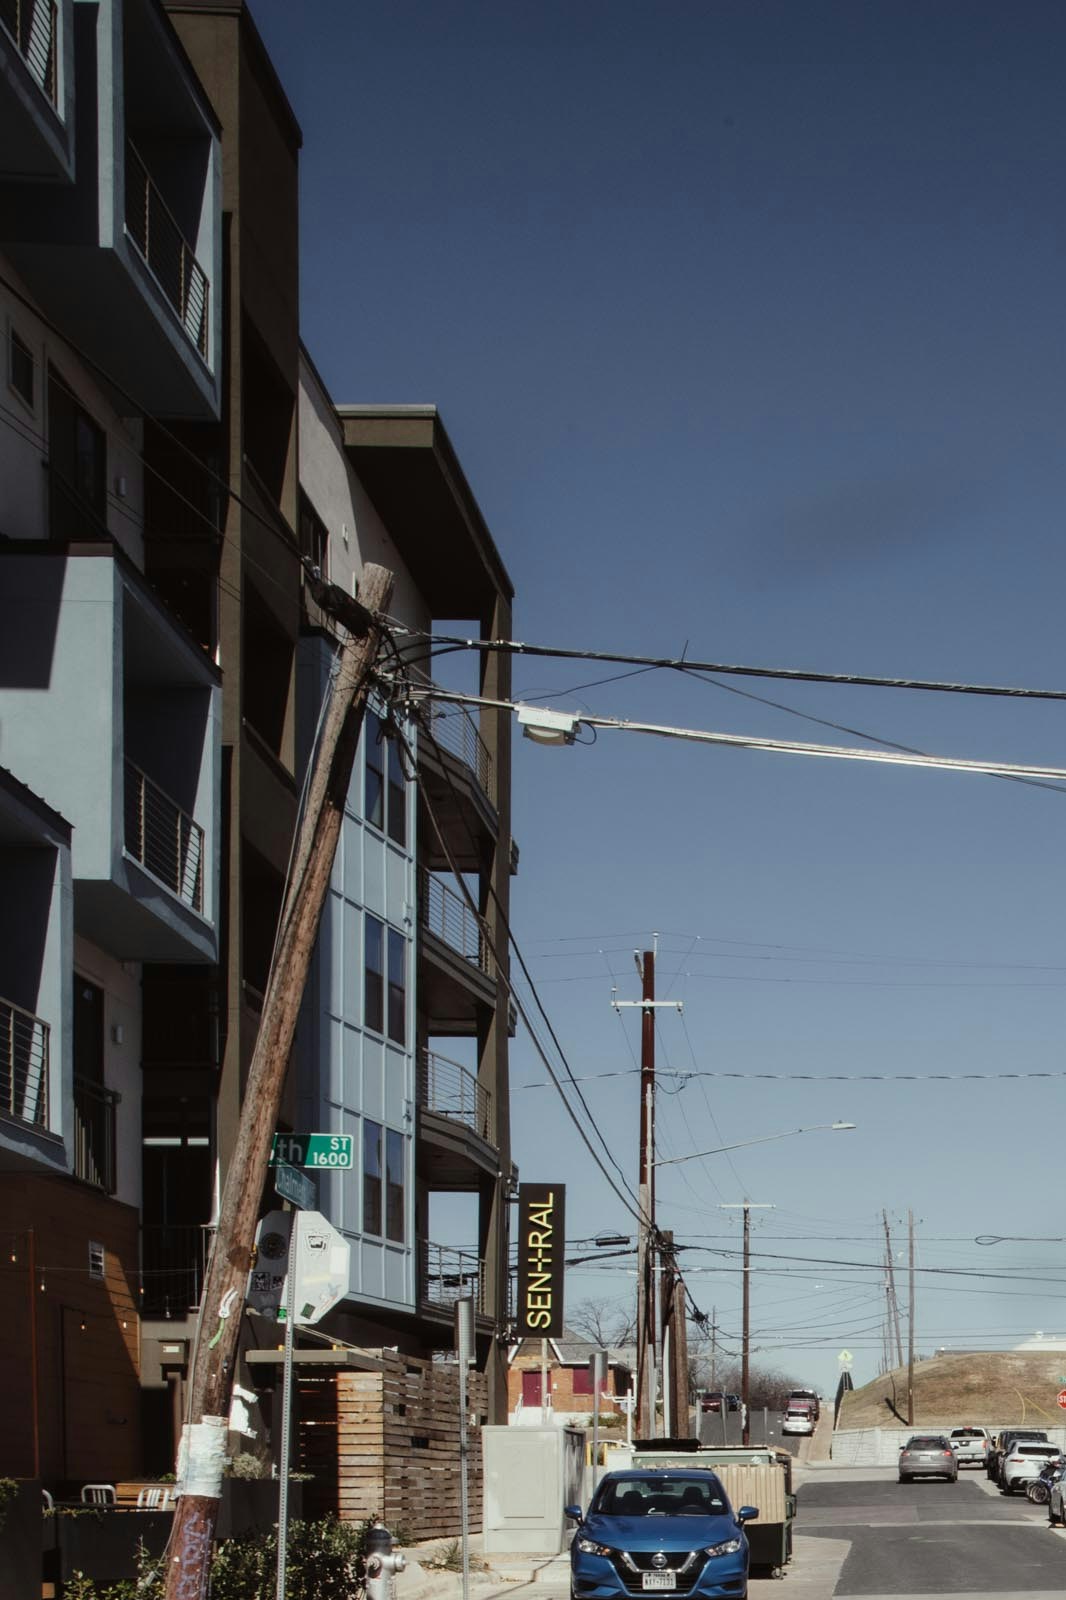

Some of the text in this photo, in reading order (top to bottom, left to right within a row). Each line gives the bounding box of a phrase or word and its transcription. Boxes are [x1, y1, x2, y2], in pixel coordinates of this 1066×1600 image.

[270, 1137, 349, 1162] th ST
[313, 1151, 349, 1165] 1600
